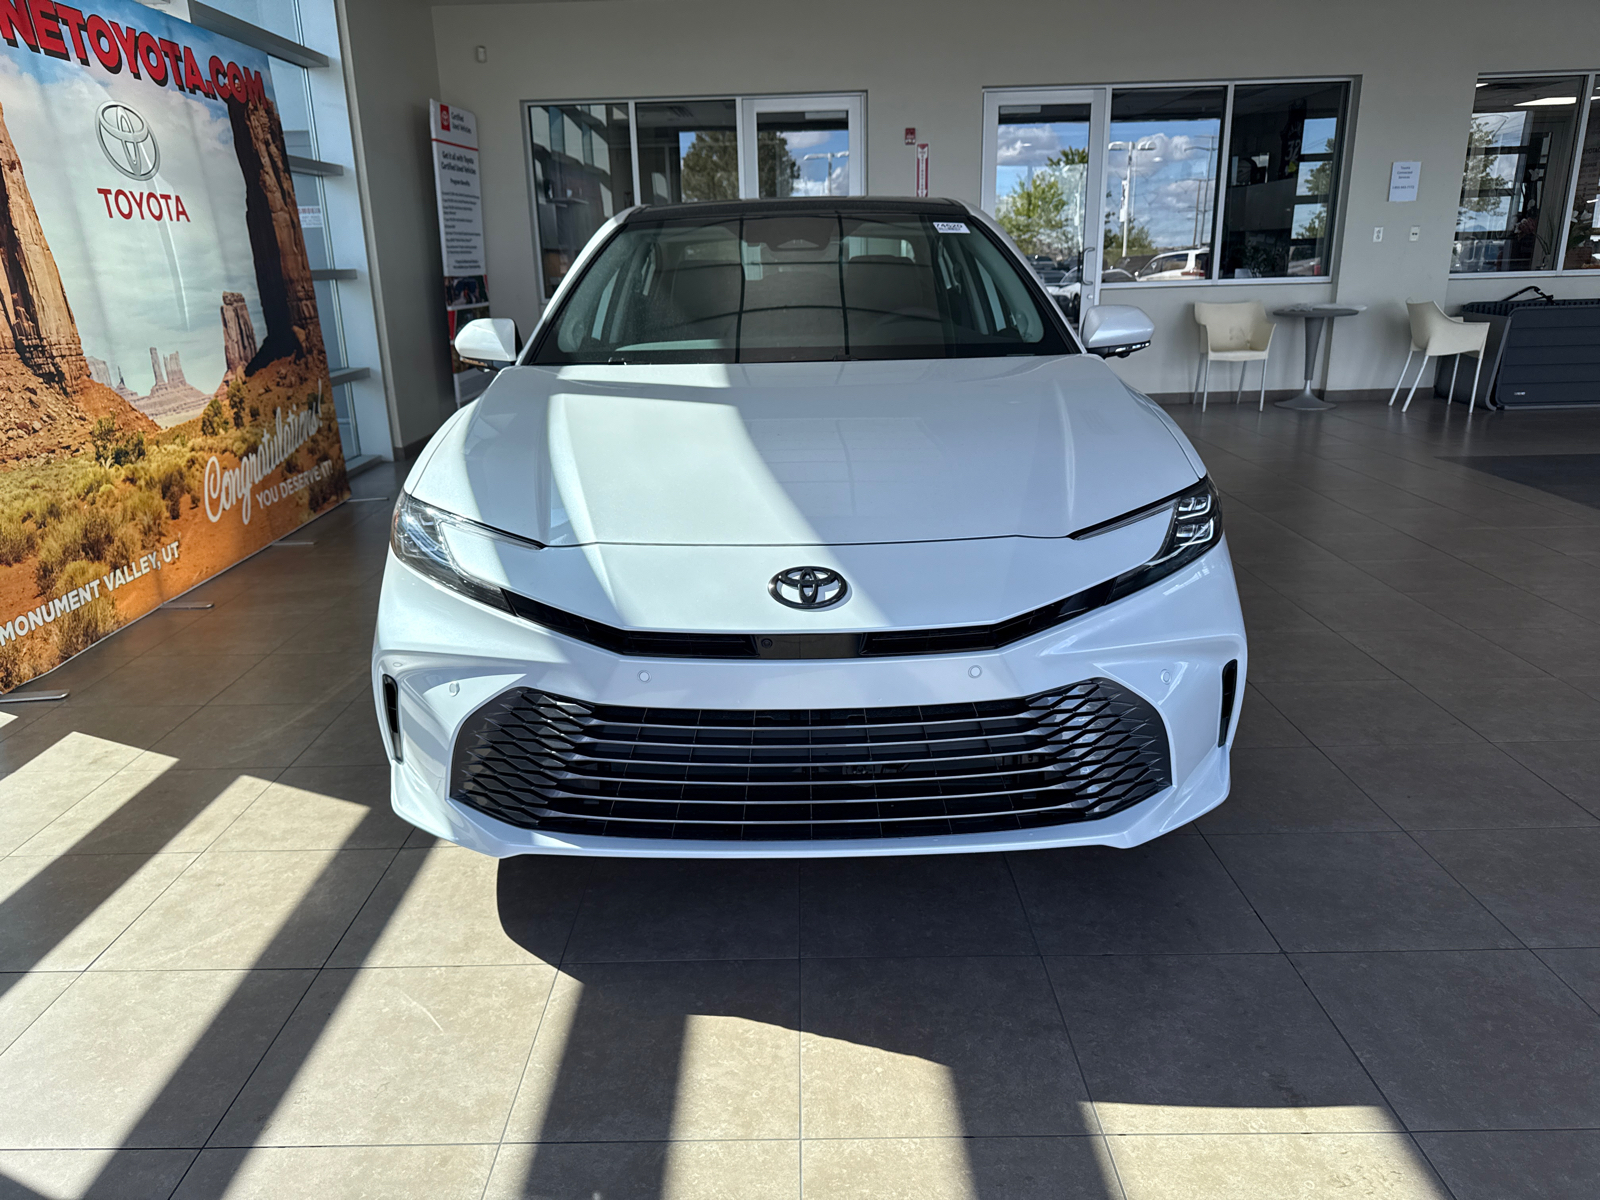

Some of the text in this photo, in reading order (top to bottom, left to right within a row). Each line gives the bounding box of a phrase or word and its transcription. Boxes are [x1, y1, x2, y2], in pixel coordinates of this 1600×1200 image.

[97, 188, 191, 223] TOYOTA
[204, 377, 324, 526] Congratulations!
[255, 459, 334, 509] YOU DESERVE IT!
[0, 541, 180, 647] MONUMENT VALLEY, UT
